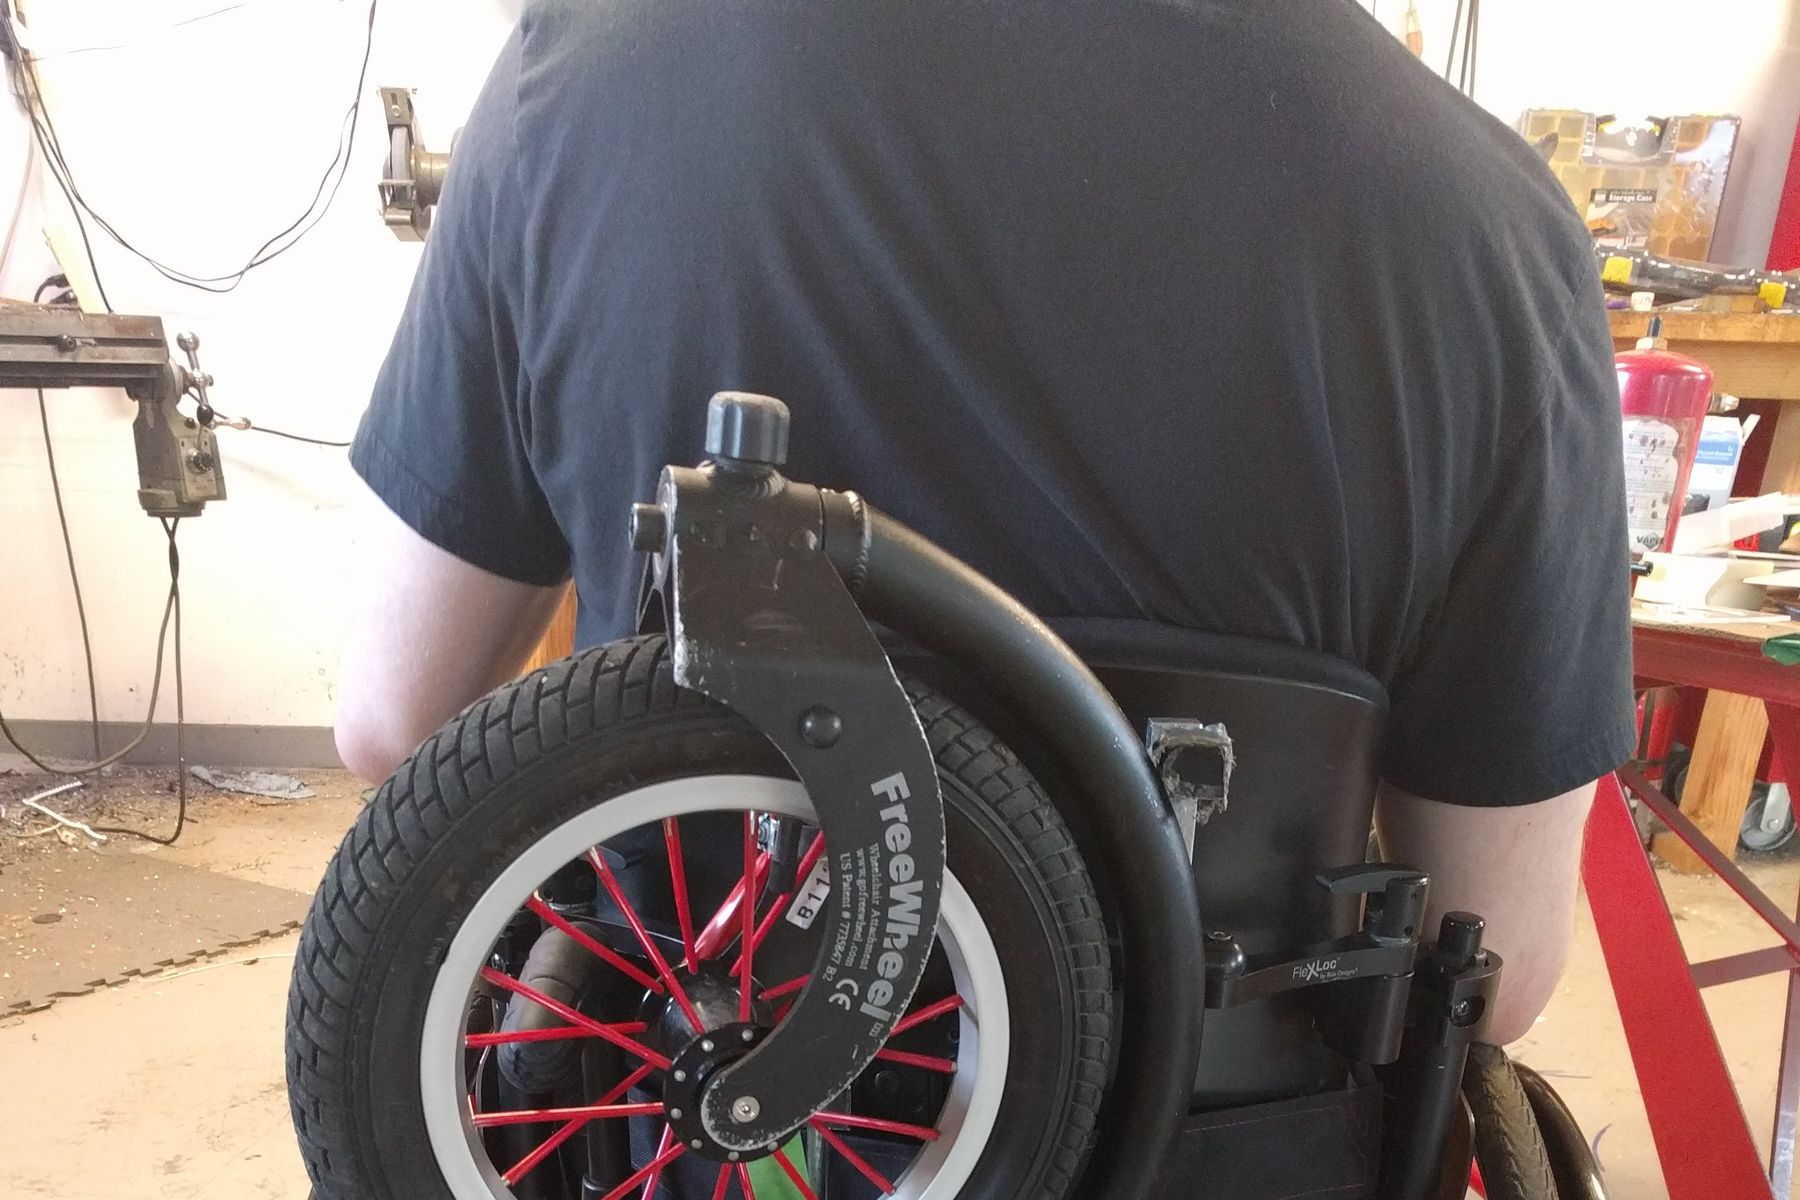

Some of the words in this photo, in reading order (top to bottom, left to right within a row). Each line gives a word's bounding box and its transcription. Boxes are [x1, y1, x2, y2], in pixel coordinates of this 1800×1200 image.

[839, 852, 852, 872] US
[870, 842, 882, 905] Wheelchair
[797, 866, 830, 918] B11
[841, 873, 854, 912] Patent
[843, 847, 868, 967] www.gofreewheel.com
[859, 771, 923, 1023] FreeWheel
[830, 919, 851, 964] 7735847
[859, 905, 882, 971] Attachment
